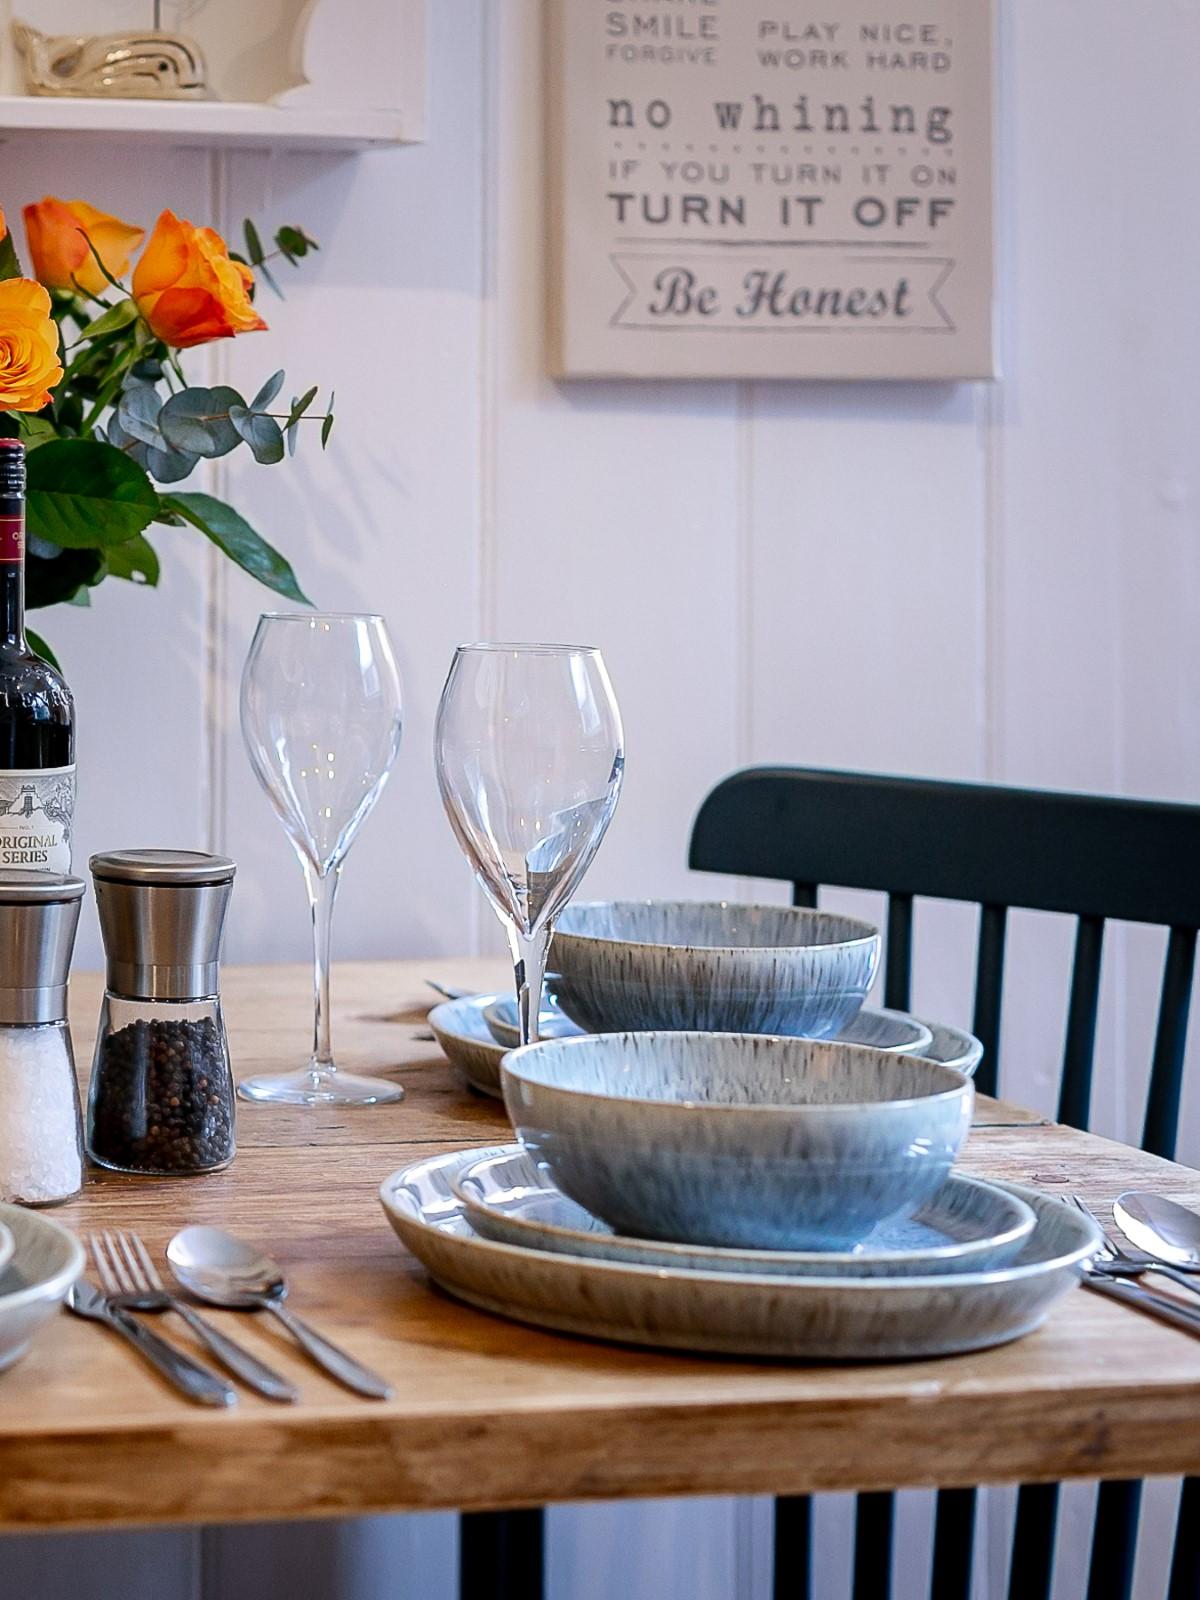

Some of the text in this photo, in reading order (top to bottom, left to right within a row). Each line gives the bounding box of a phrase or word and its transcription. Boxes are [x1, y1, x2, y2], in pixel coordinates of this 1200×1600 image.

[606, 11, 718, 40] SMILE
[757, 20, 840, 42] PLAY
[605, 44, 717, 65] FORGIVE
[757, 48, 952, 73] WORK HARD
[607, 94, 953, 144] no whining
[608, 159, 957, 188] IF YOU TURN IT ON
[607, 192, 955, 228] TURN IT OFF
[648, 267, 912, 319] Be Honest
[2, 850, 48, 864] SERIES
